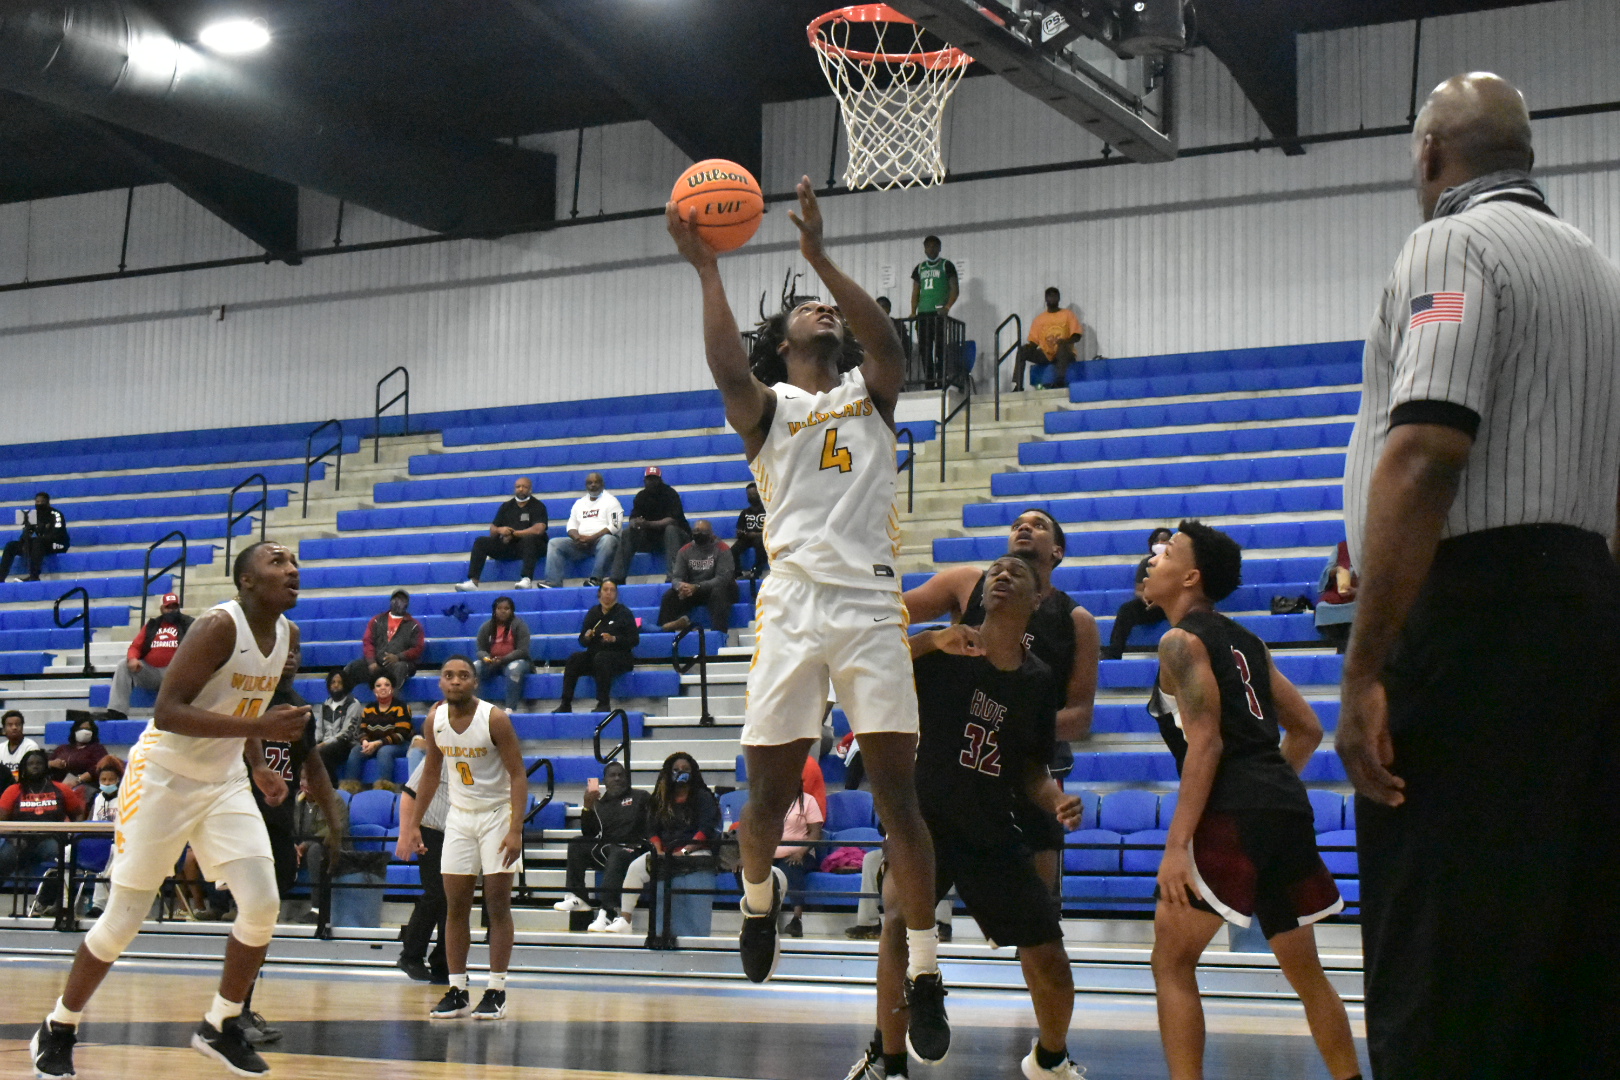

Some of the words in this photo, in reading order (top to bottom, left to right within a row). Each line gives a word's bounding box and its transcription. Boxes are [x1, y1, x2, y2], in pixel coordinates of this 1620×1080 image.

[687, 168, 750, 188] Wilson
[924, 278, 934, 290] 11
[819, 428, 852, 474] 4
[439, 745, 488, 758] WILDCATS
[959, 722, 1001, 777] 32
[265, 746, 294, 781] 22
[455, 761, 475, 786] 0
